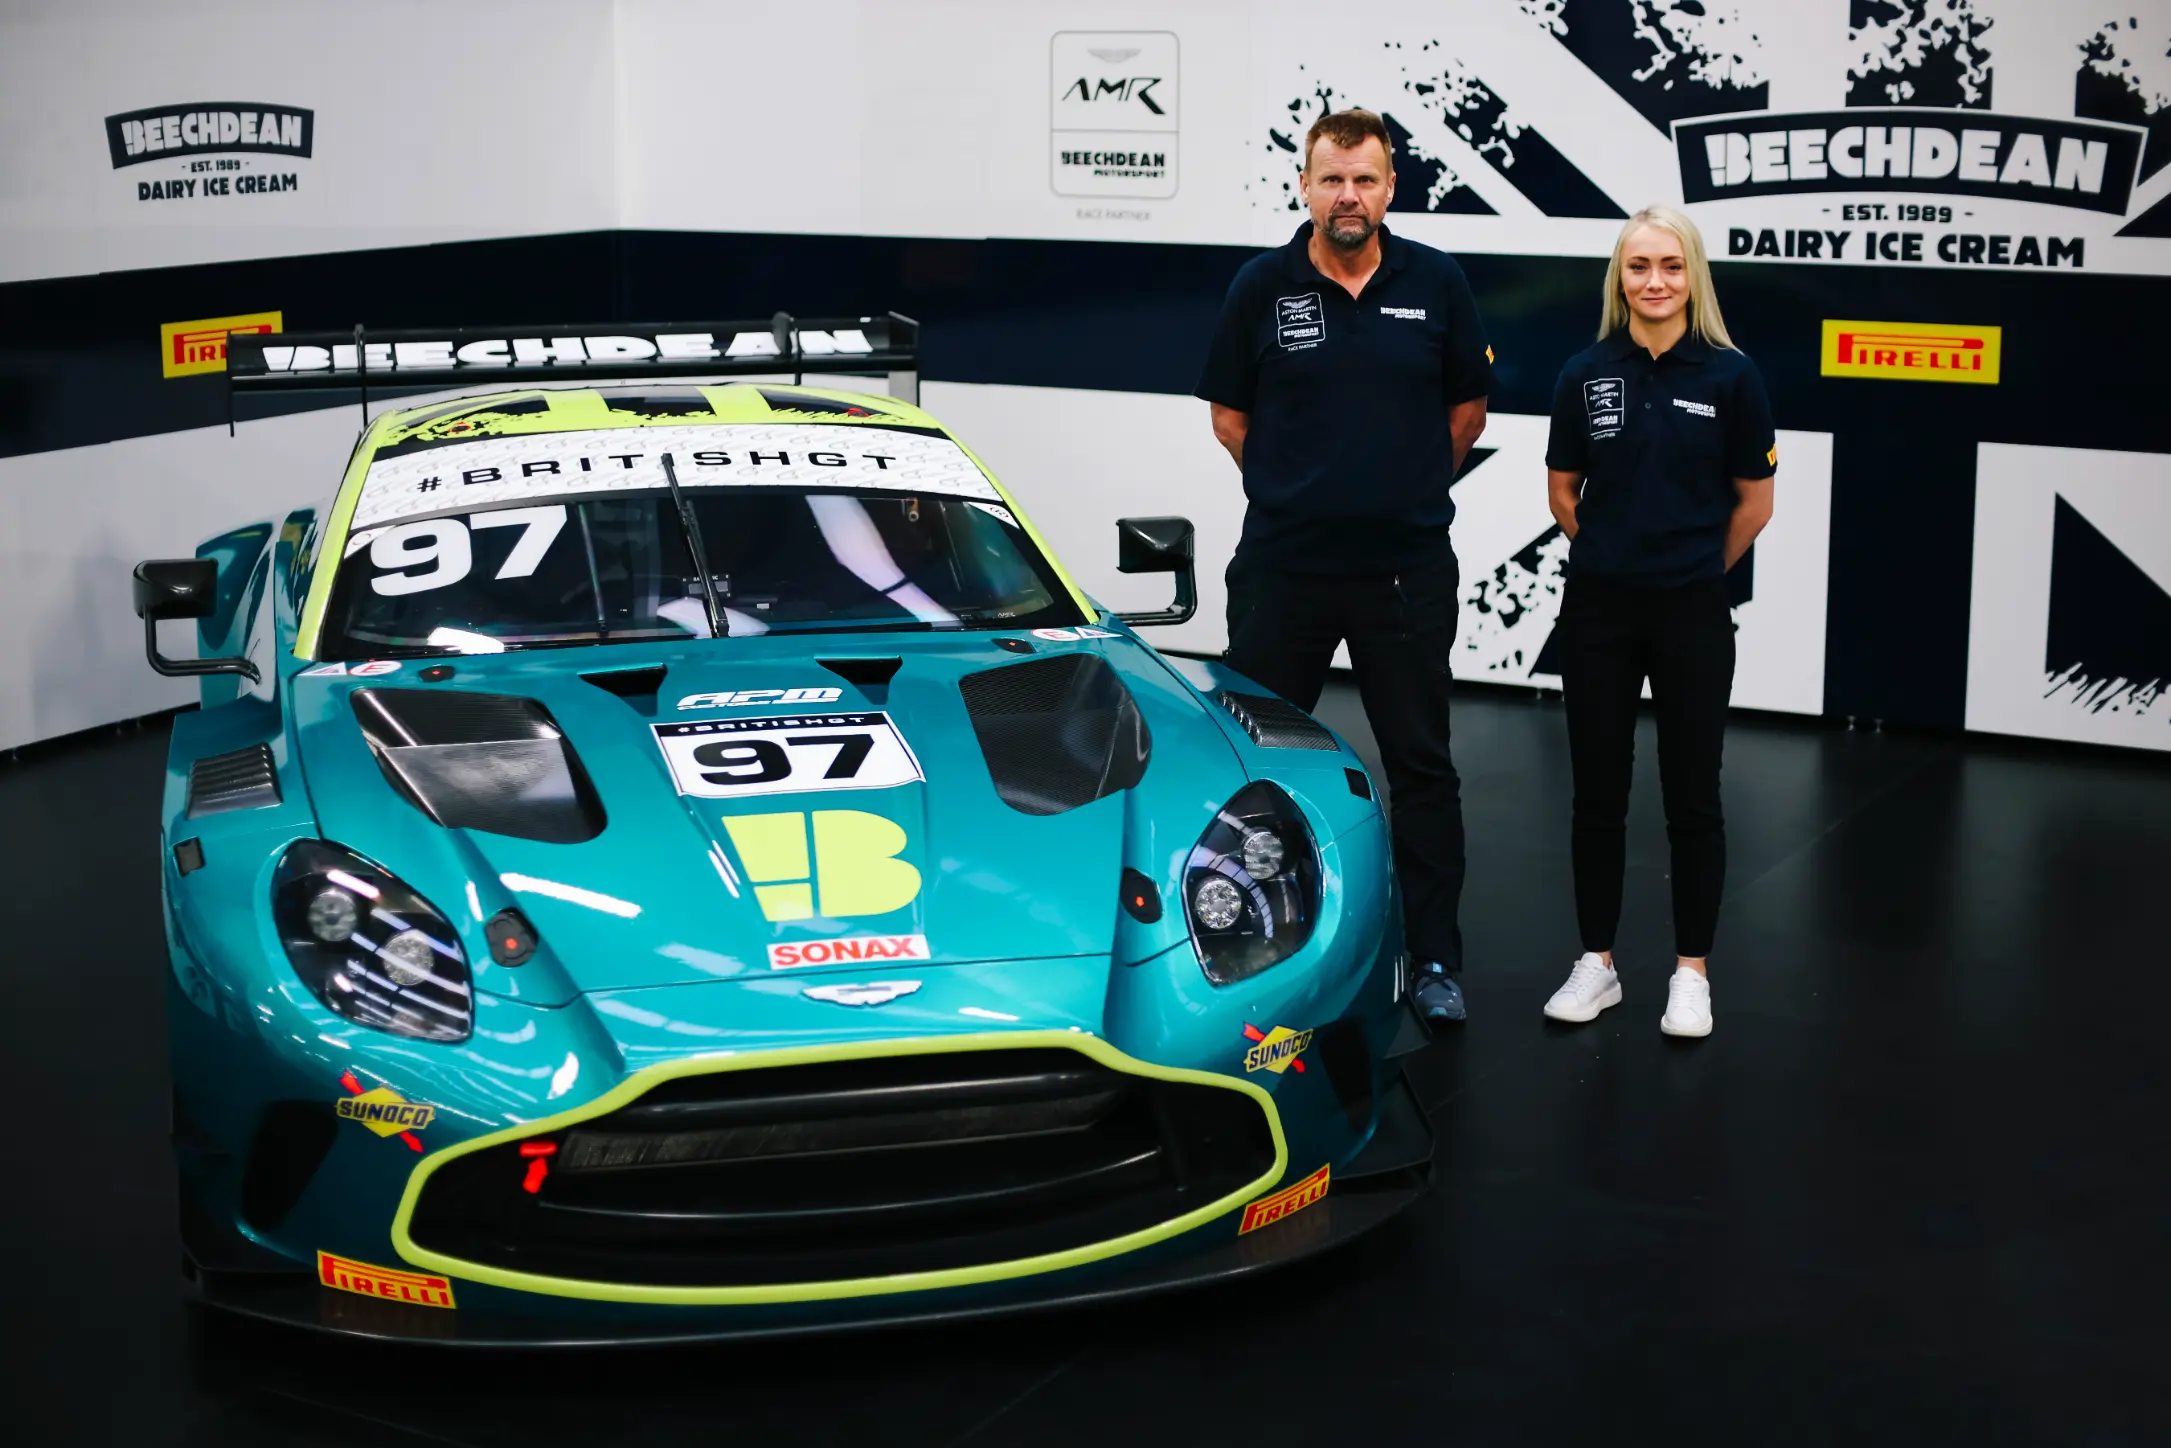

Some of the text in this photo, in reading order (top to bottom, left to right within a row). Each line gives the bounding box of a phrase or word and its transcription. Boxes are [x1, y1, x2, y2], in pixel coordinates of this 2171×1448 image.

[1062, 77, 1167, 115] AMR
[121, 112, 302, 156] BEECHDEAN
[191, 160, 241, 172] EST. 1989
[1061, 151, 1165, 167] BEECHDEAN
[1703, 125, 2108, 194] BEECHDEAN
[138, 173, 298, 201] DAIRY ICE CREAM
[1842, 204, 1953, 224] EST. 1989
[1728, 228, 2085, 268] DAIRY ICE CREAM
[262, 330, 874, 371] BEECHDEAN
[1837, 333, 1984, 372] PIRELLI
[416, 450, 897, 493] #BRITSHGT
[370, 504, 567, 597] 97
[677, 716, 866, 733] #BRITISHGT
[693, 733, 875, 786] 97
[774, 937, 919, 967] SONAX
[1248, 1030, 1313, 1069] SUNOCO
[340, 1100, 430, 1127] SUNOCO
[1240, 1166, 1330, 1234] PIRELLI
[321, 1254, 450, 1307] PIRELLI
